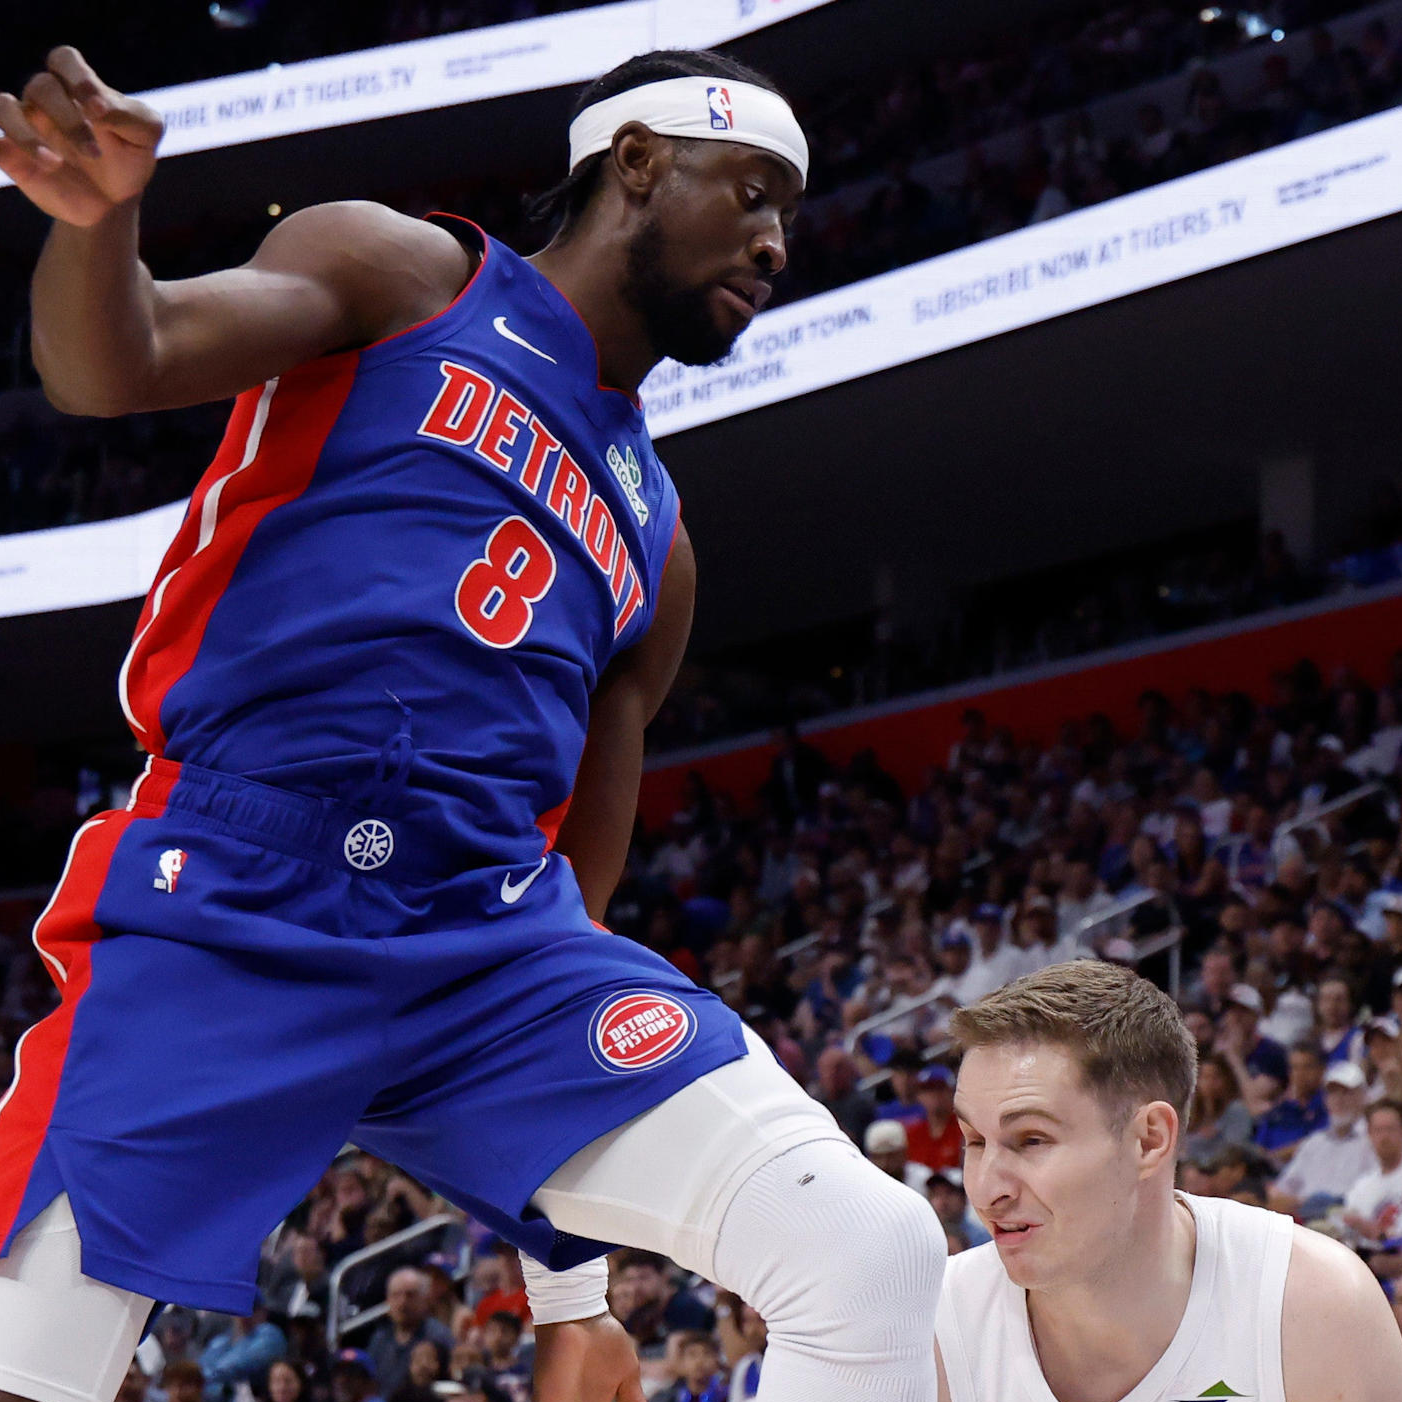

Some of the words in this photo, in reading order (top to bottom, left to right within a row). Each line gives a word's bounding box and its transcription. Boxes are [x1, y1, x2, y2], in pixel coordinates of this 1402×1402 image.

[219, 95, 265, 119] NOW
[274, 87, 298, 110] AT
[914, 264, 1034, 322] SUBSCRIBE
[1040, 245, 1089, 278] NOW
[1097, 235, 1122, 261] AT
[752, 324, 803, 356] YOUR
[418, 360, 644, 640] DETROIT
[454, 515, 557, 649] 8
[607, 1004, 668, 1043] DETROIT
[614, 1014, 677, 1056] PISTONS
